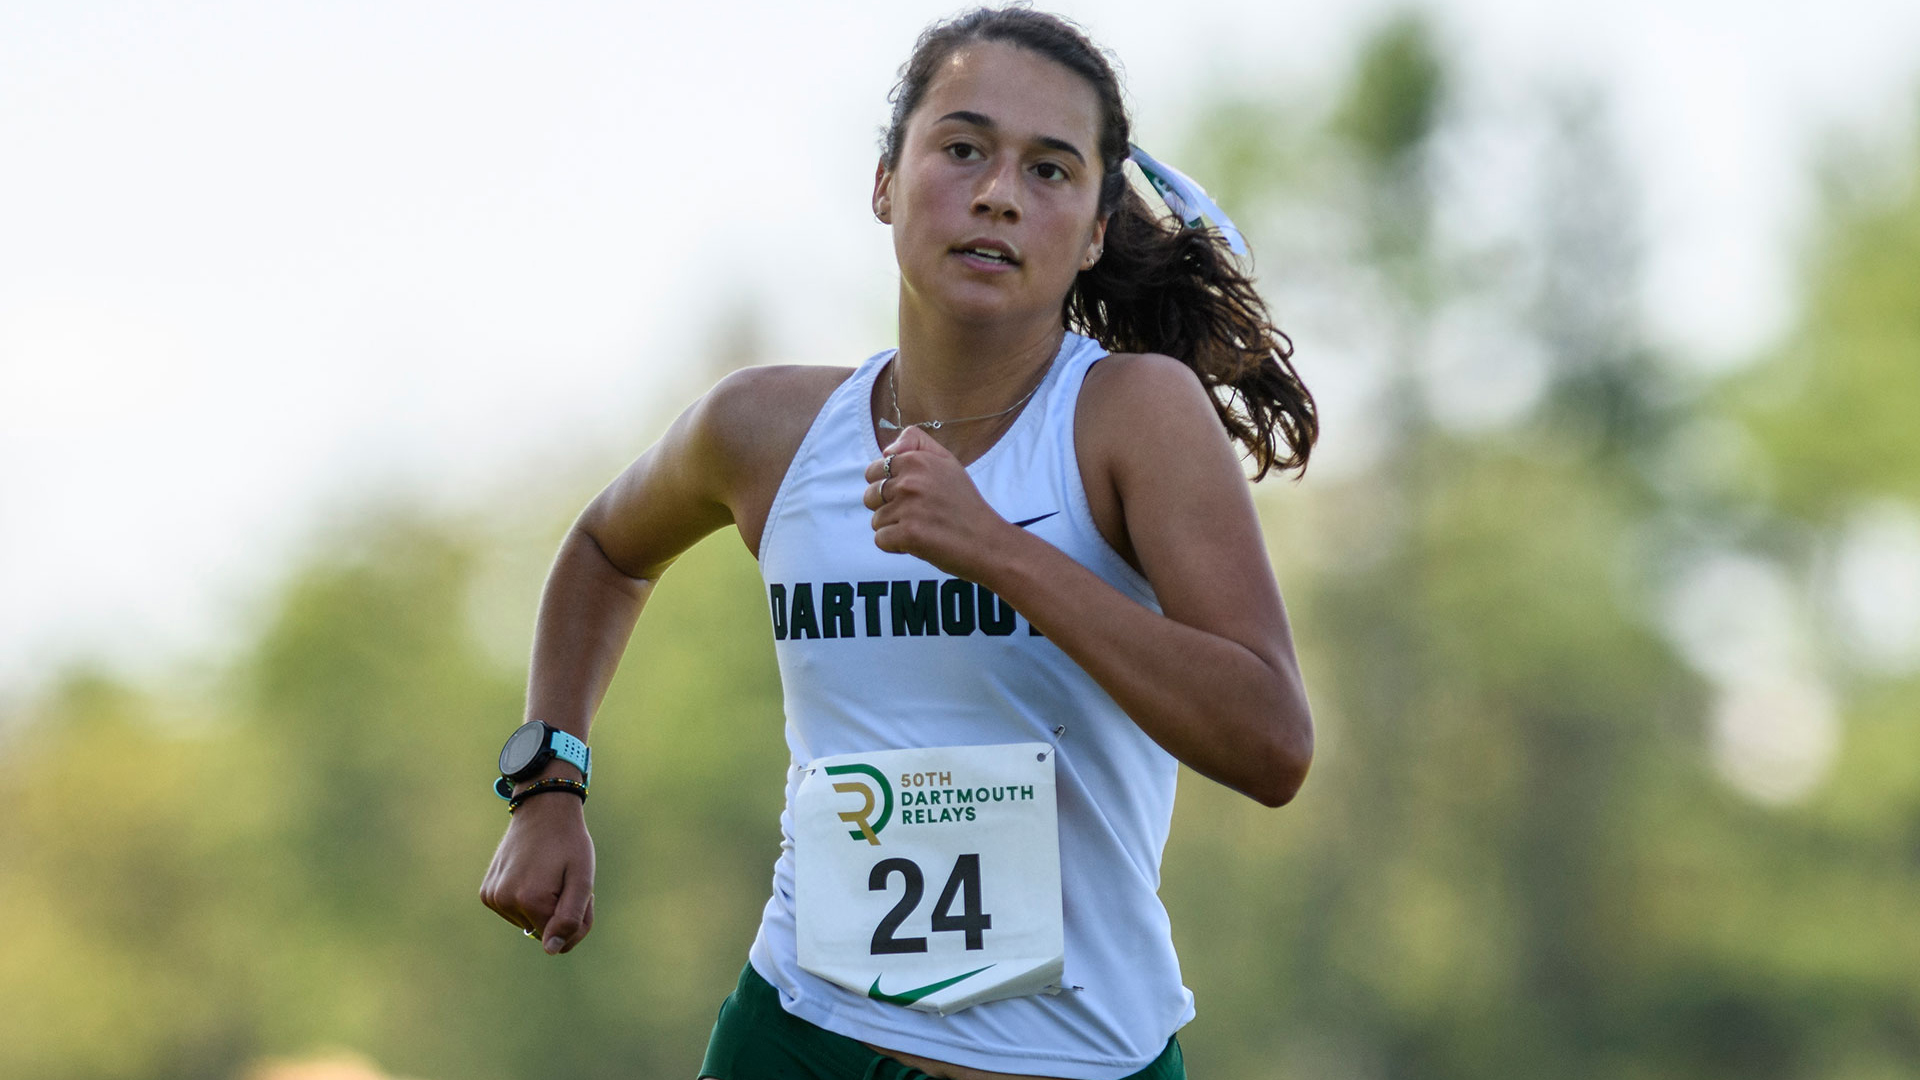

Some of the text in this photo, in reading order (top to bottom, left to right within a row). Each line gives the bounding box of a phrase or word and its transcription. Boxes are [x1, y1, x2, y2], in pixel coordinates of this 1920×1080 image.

[769, 579, 1046, 640] DARTMOU
[901, 772, 952, 787] 50TH
[901, 785, 1034, 806] DARTMOUTH
[902, 807, 976, 825] RELAYS
[868, 853, 992, 955] 24
